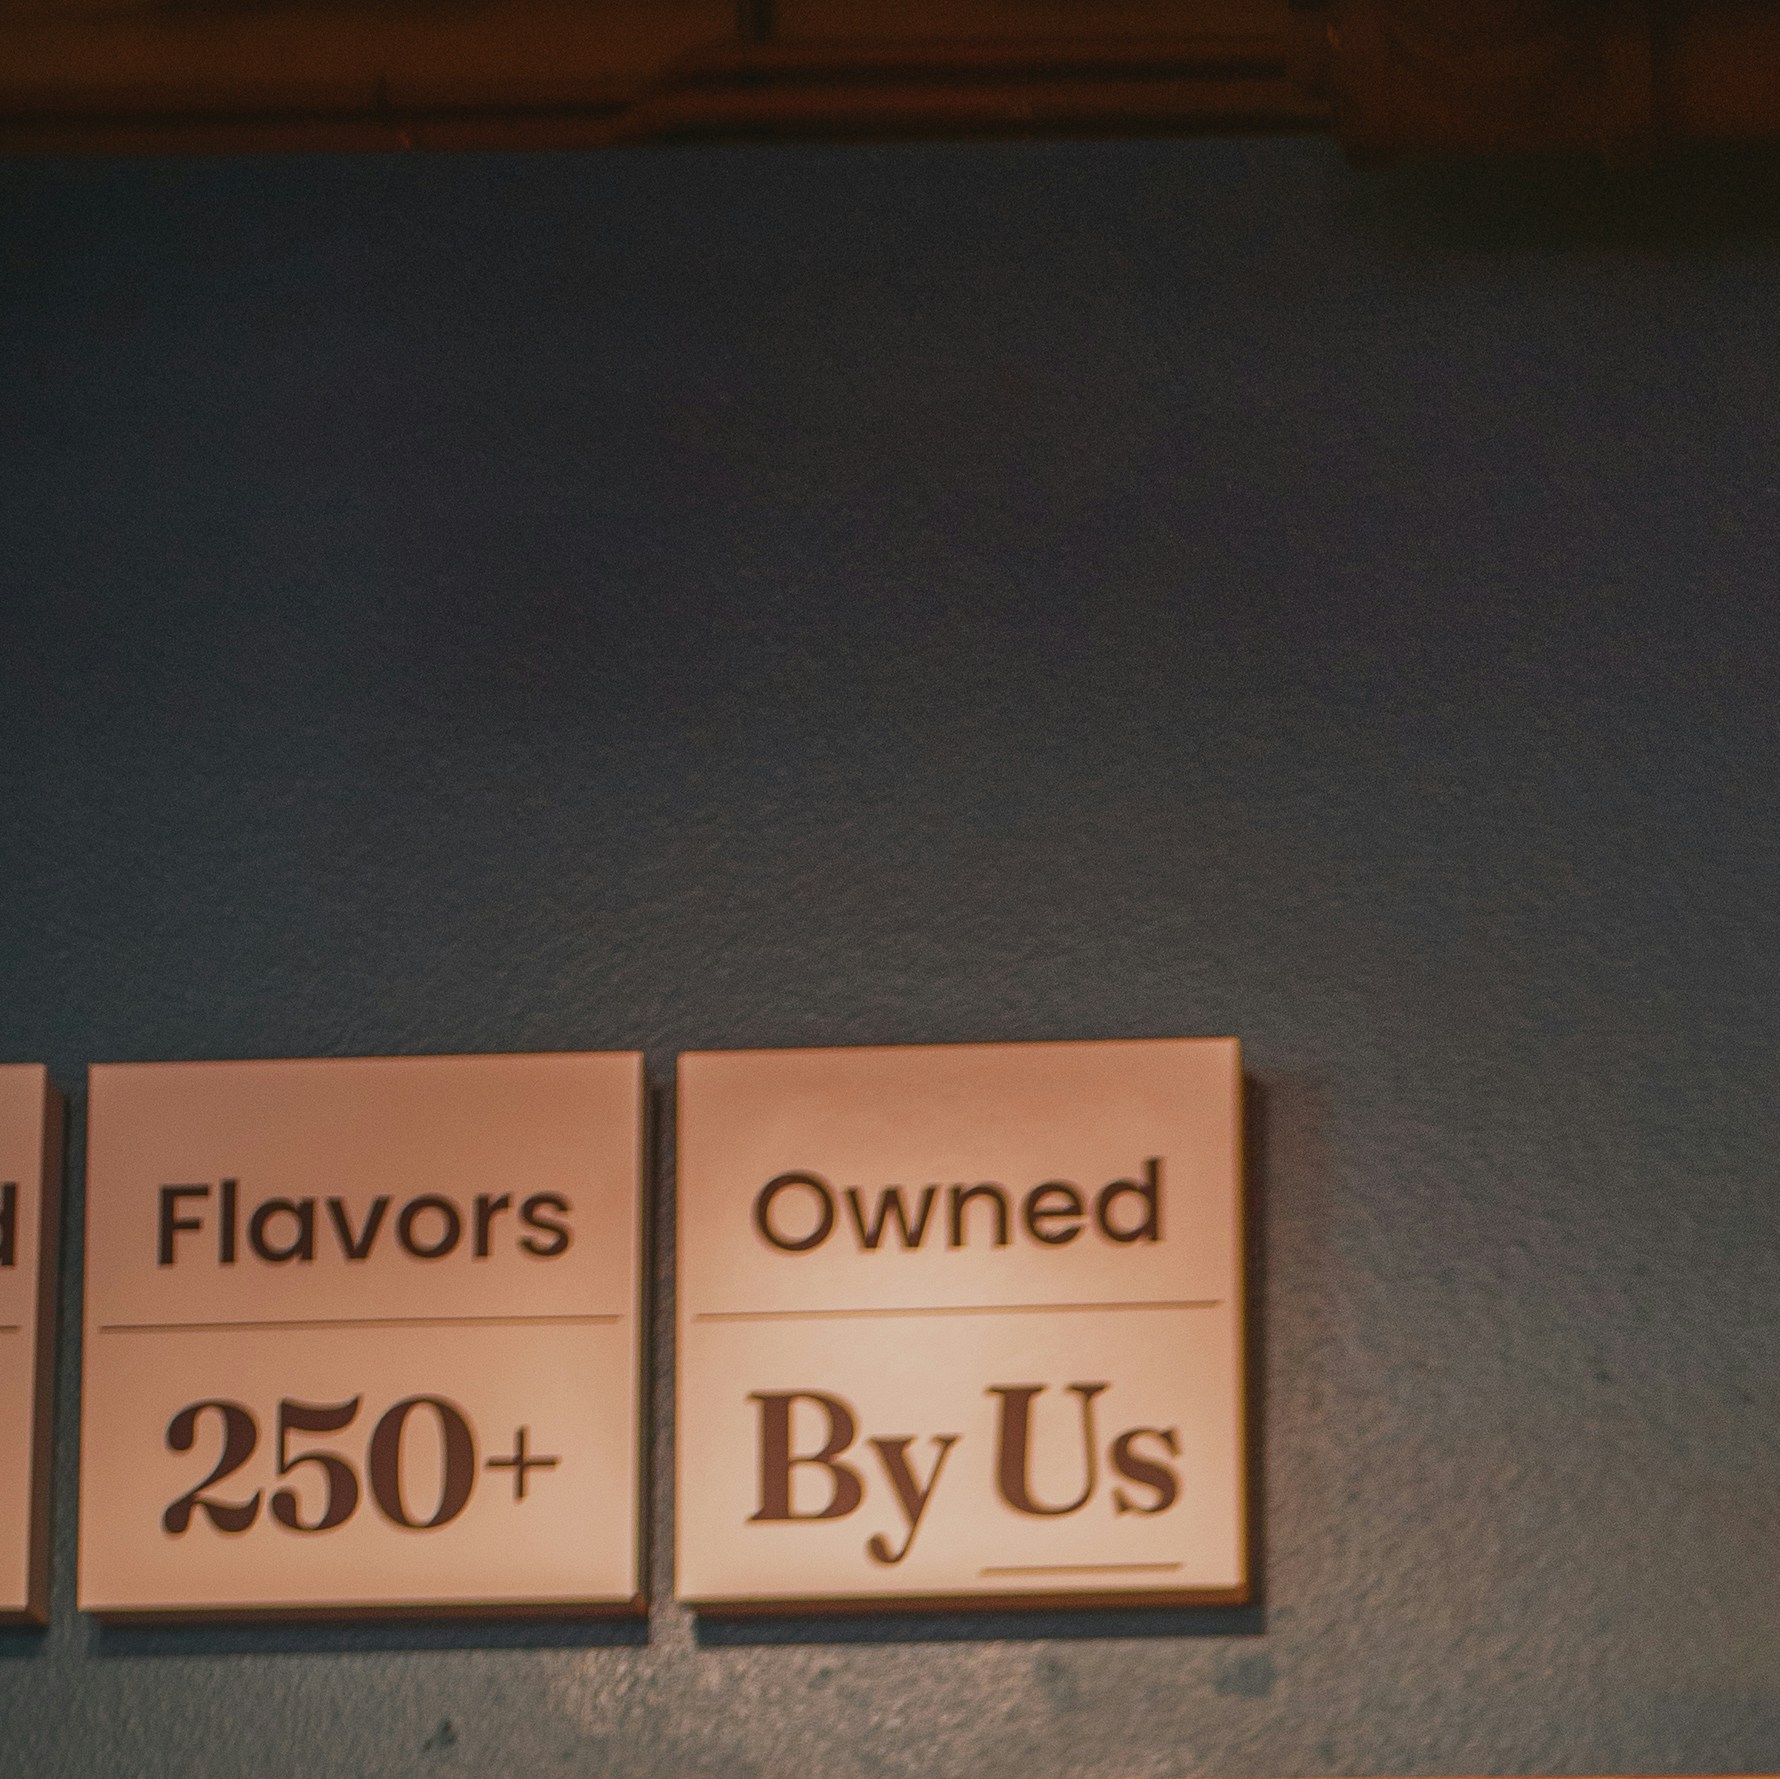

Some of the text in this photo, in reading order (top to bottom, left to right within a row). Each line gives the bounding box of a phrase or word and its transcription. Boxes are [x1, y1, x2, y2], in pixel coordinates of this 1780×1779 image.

[157, 1180, 575, 1268] Flavors
[752, 1156, 1162, 1255] Owned
[163, 1393, 562, 1535] 250+
[747, 1382, 1185, 1565] By Us
